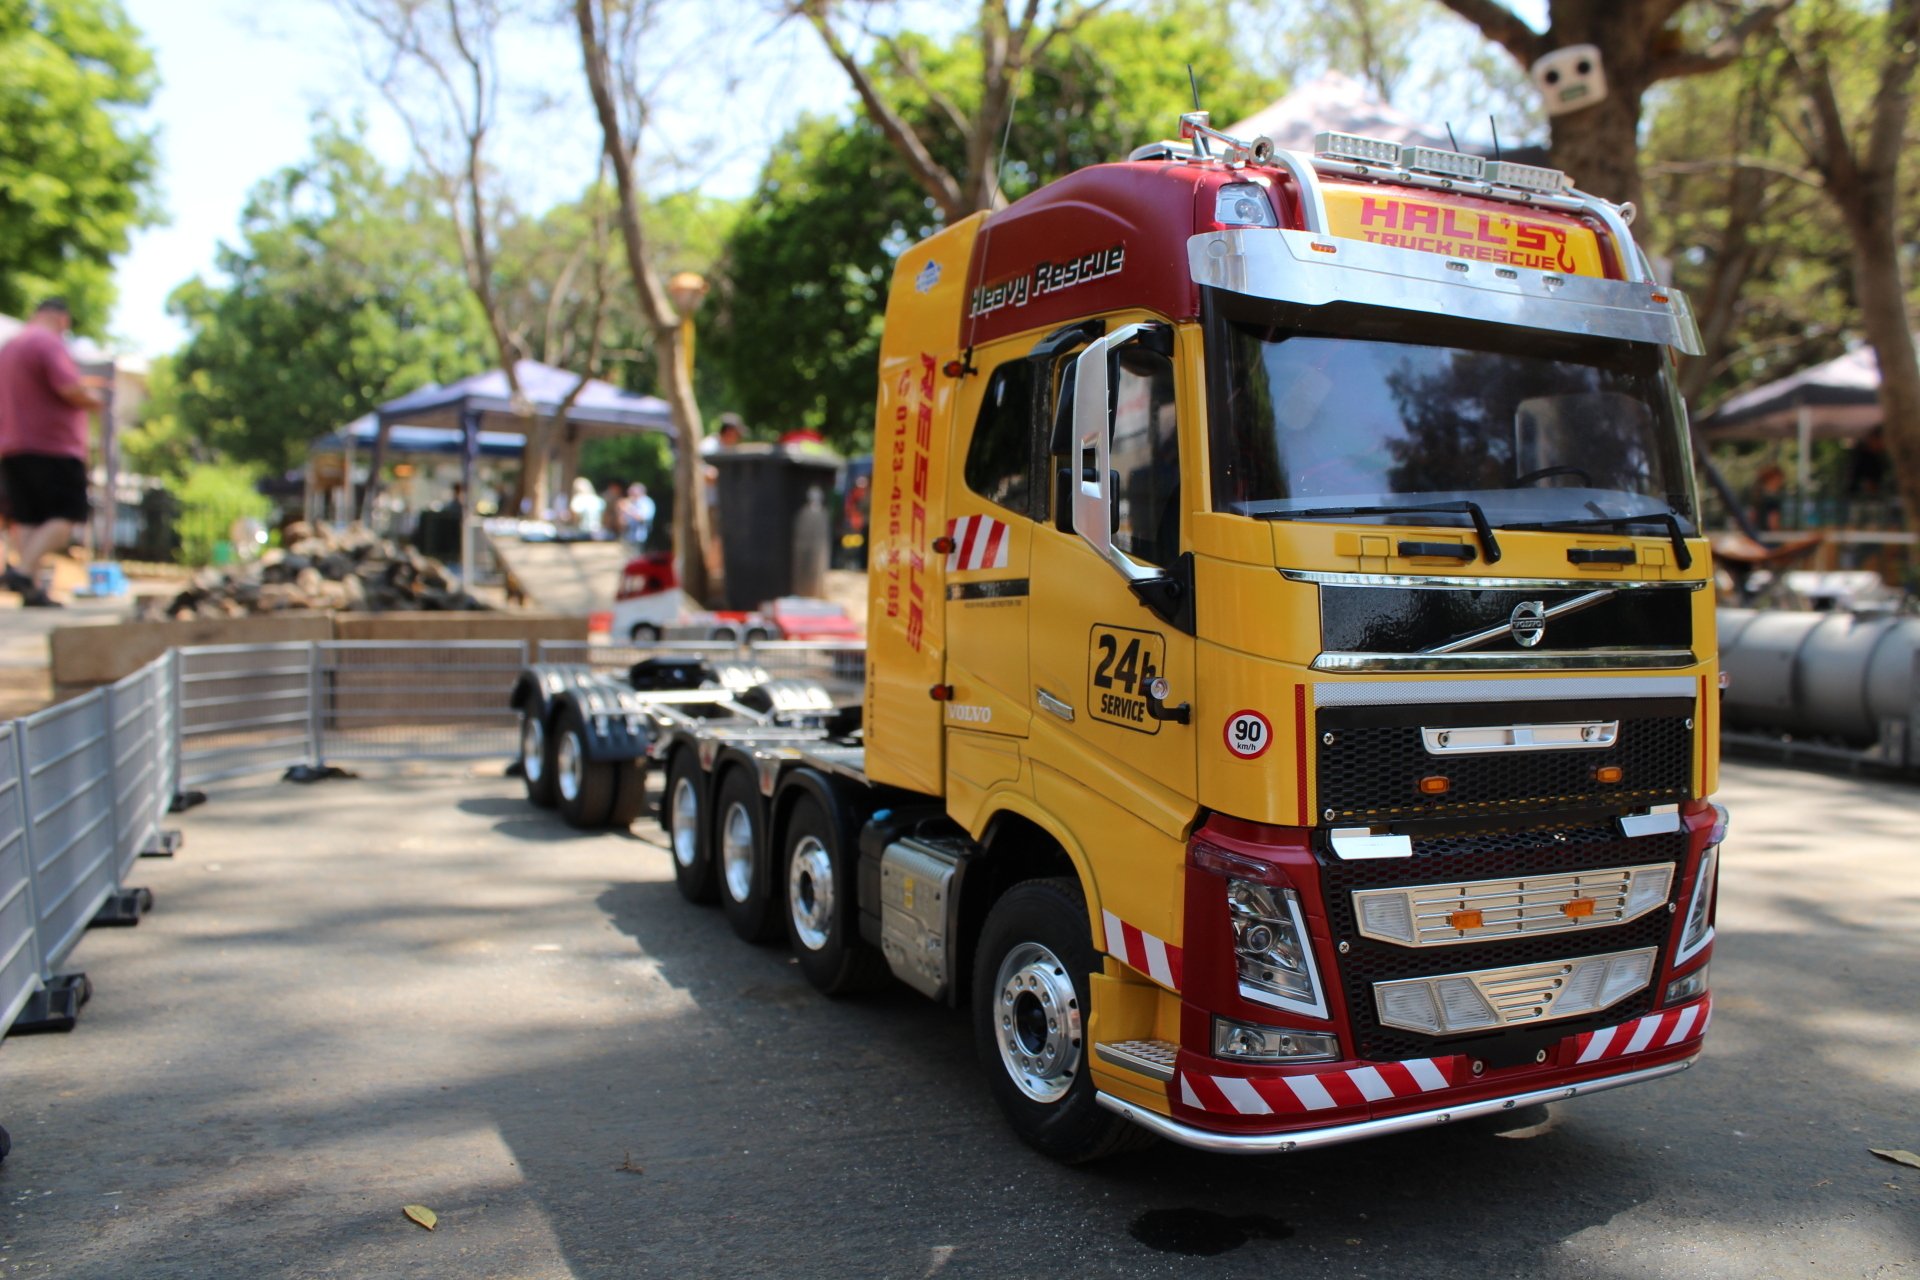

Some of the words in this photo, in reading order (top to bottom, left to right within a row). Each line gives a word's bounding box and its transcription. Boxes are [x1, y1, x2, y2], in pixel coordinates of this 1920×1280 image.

[1360, 197, 1566, 251] HALL'S
[1363, 231, 1452, 255] TRUCK
[1458, 243, 1555, 270] RESCUE
[969, 275, 1030, 318] Heavy
[1032, 244, 1125, 297] Rescue
[907, 352, 936, 653] RESCUE
[947, 703, 992, 723] VOLVO
[1101, 693, 1146, 723] SERVICE
[1235, 719, 1261, 742] 90
[1237, 742, 1256, 751] km/h
